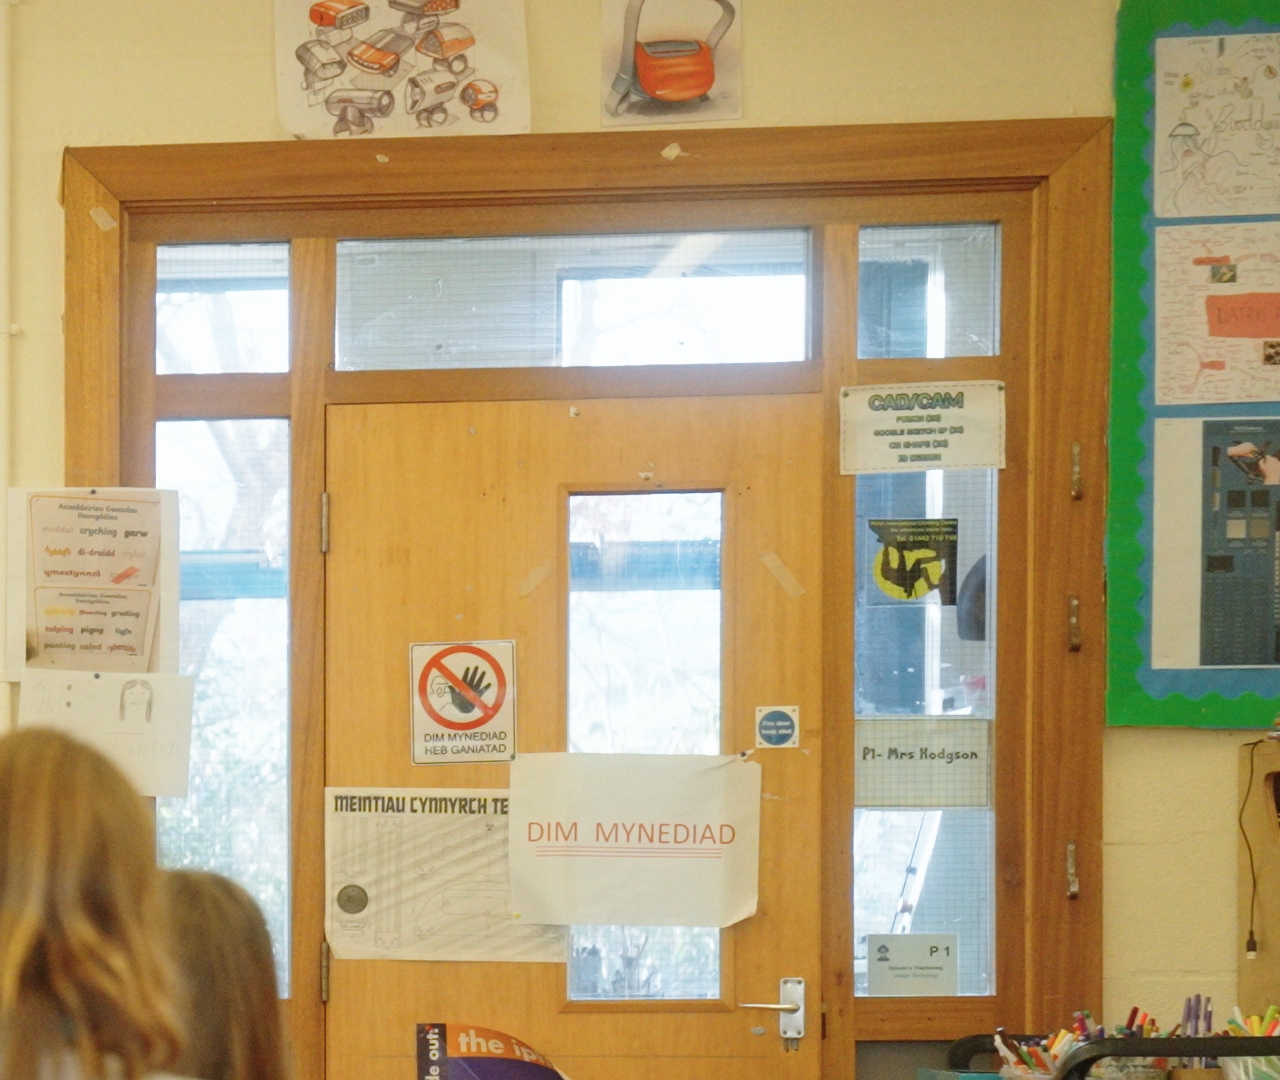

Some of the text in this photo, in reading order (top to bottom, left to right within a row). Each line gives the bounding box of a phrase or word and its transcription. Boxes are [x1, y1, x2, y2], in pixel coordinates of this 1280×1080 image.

[868, 392, 964, 411] CAD/CAM
[80, 527, 117, 538] crychiog
[124, 530, 149, 539] garw
[77, 548, 116, 557] di-draidd
[81, 626, 104, 636] pigog
[424, 731, 507, 743] DIM MYNEDIAD
[424, 743, 507, 755] HEB GANIATAD
[887, 747, 915, 760] Mrs
[920, 747, 978, 764] Hodgson
[334, 795, 406, 813] MEINTIAU
[410, 797, 488, 815] CYNNYRCH
[528, 821, 736, 845] DIM MYNEDIAD
[930, 945, 950, 957] P 1
[458, 1029, 506, 1054] the
